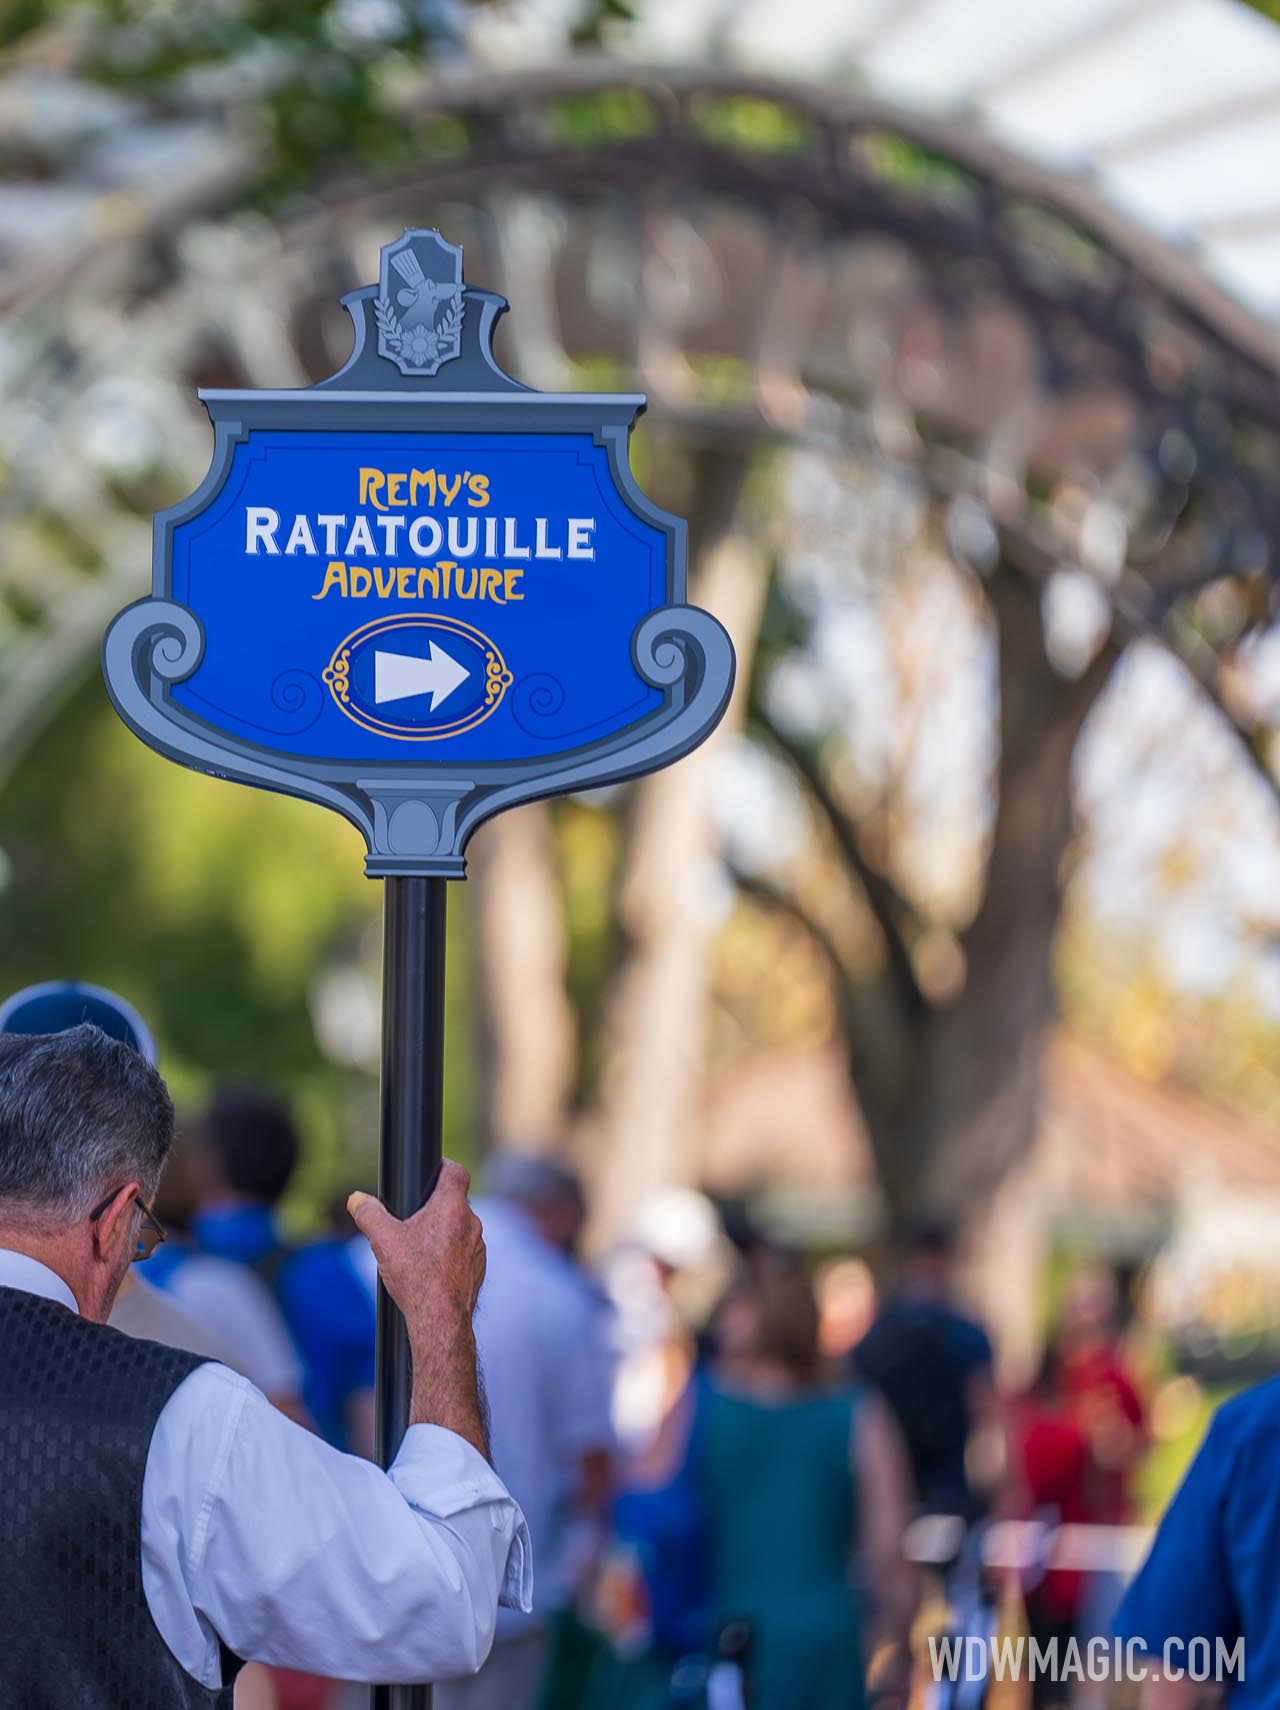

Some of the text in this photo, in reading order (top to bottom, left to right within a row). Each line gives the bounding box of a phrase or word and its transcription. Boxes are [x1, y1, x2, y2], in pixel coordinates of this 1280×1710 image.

[359, 468, 489, 510] REMY'S
[245, 507, 596, 560] RATATOUILLE
[312, 561, 524, 604] ADVENTURE
